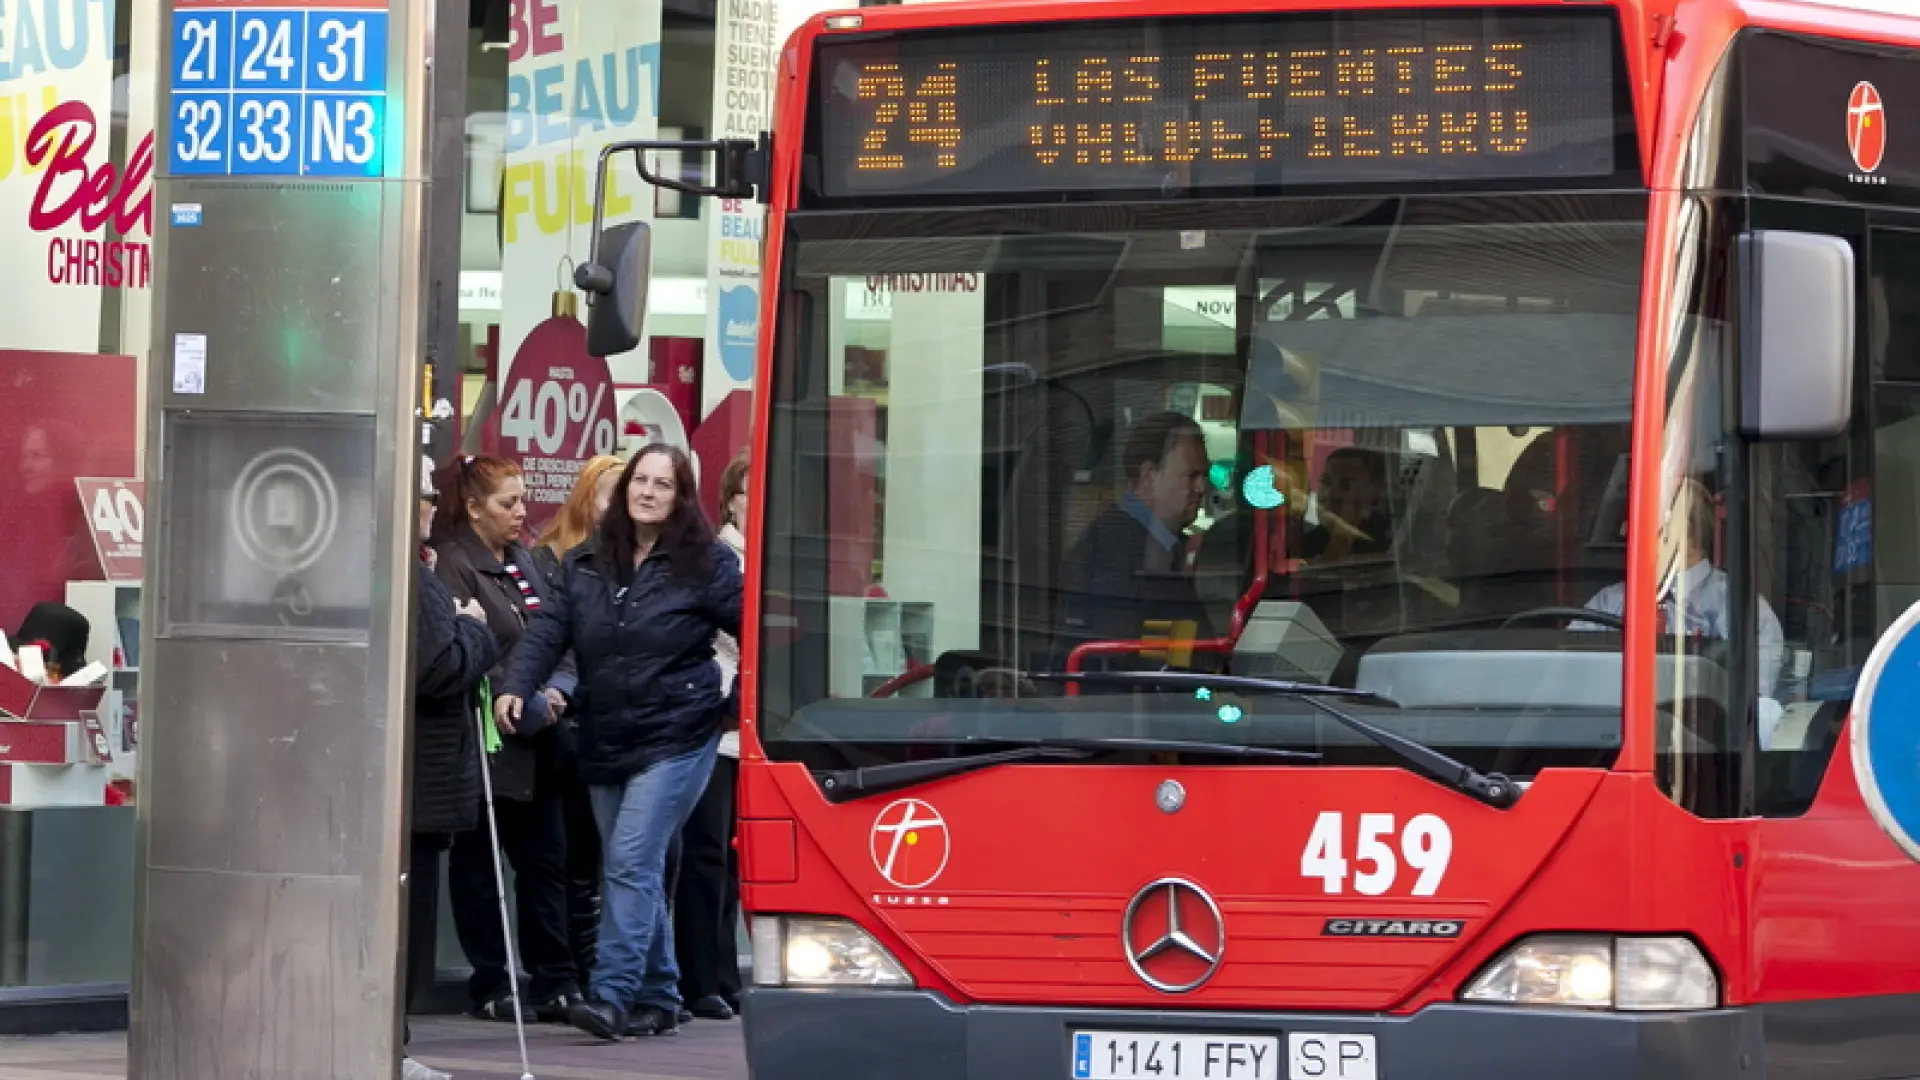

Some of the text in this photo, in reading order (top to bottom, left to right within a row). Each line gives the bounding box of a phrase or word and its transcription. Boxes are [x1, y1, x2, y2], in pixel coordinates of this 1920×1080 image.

[181, 20, 217, 81] 21
[241, 19, 294, 80] 24
[316, 20, 365, 82] 31
[729, 21, 776, 45] TIENE
[726, 90, 760, 112] CON
[1036, 44, 1523, 104] LAS FUENTES
[178, 100, 221, 162] 32
[238, 100, 291, 162] 33
[311, 101, 374, 163] N3
[858, 63, 961, 169] 24
[504, 150, 632, 244] FULL
[501, 378, 615, 458] 40%
[1301, 811, 1453, 896] 459
[1328, 920, 1459, 935] CITARO
[1204, 1042, 1268, 1078] FFY
